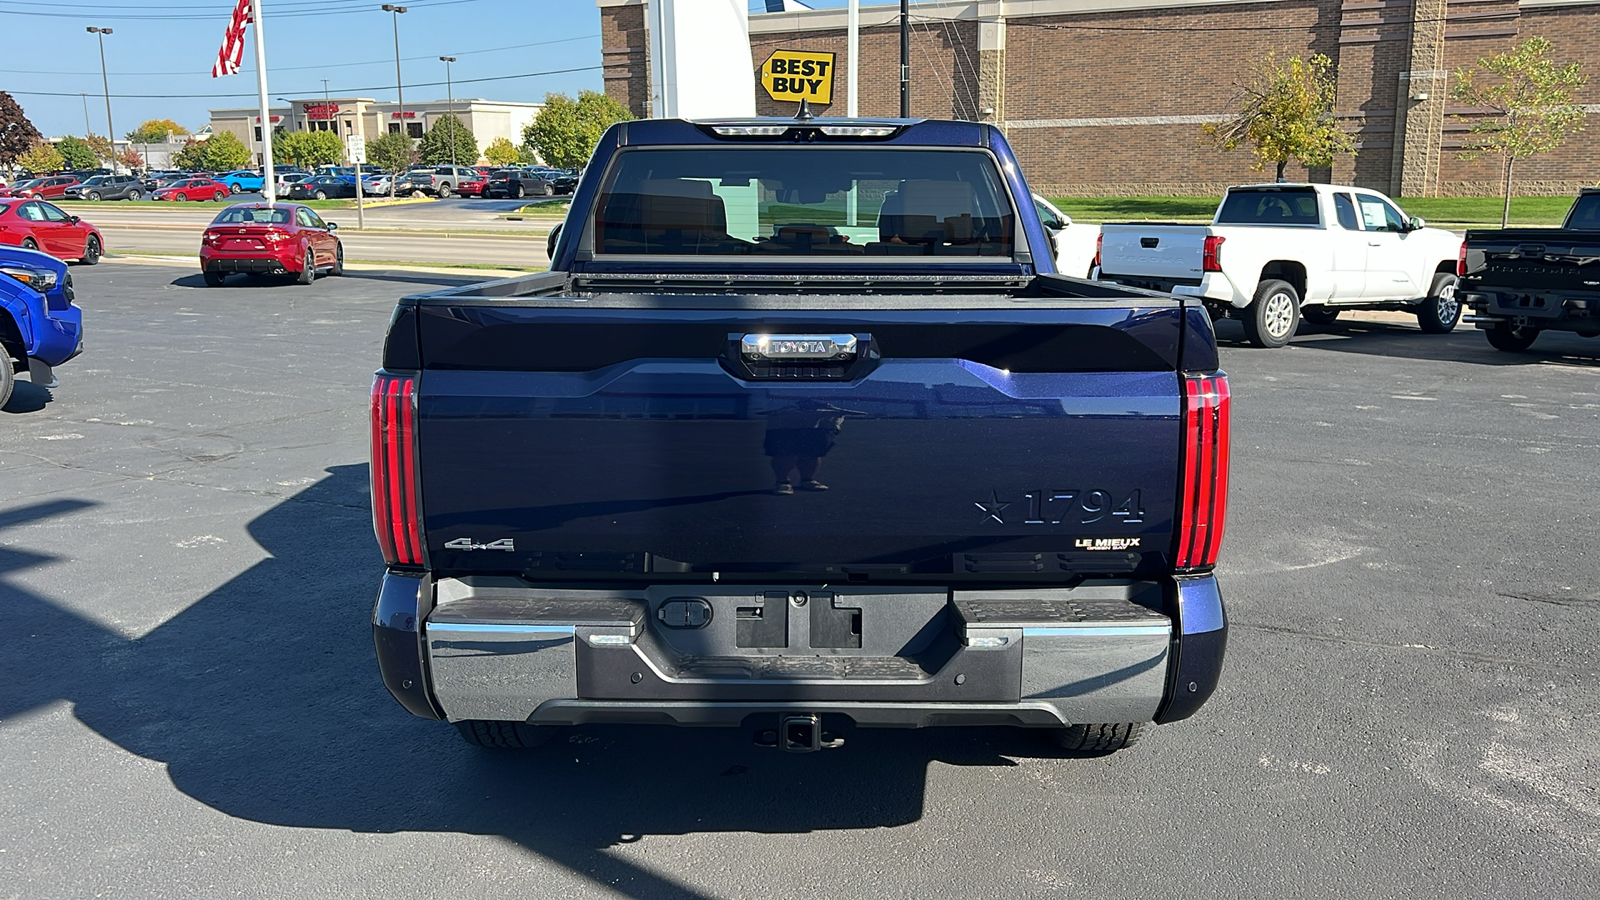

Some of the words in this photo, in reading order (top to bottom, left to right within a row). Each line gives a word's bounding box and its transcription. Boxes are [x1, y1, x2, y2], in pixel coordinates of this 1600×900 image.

[771, 59, 830, 77] BEST
[773, 77, 823, 95] BUY
[1115, 255, 1185, 264] TACOMA
[772, 341, 826, 353] TOYOTA
[1024, 489, 1146, 524] 1794
[1075, 539, 1093, 547] LE
[1095, 538, 1141, 547] MIEUX
